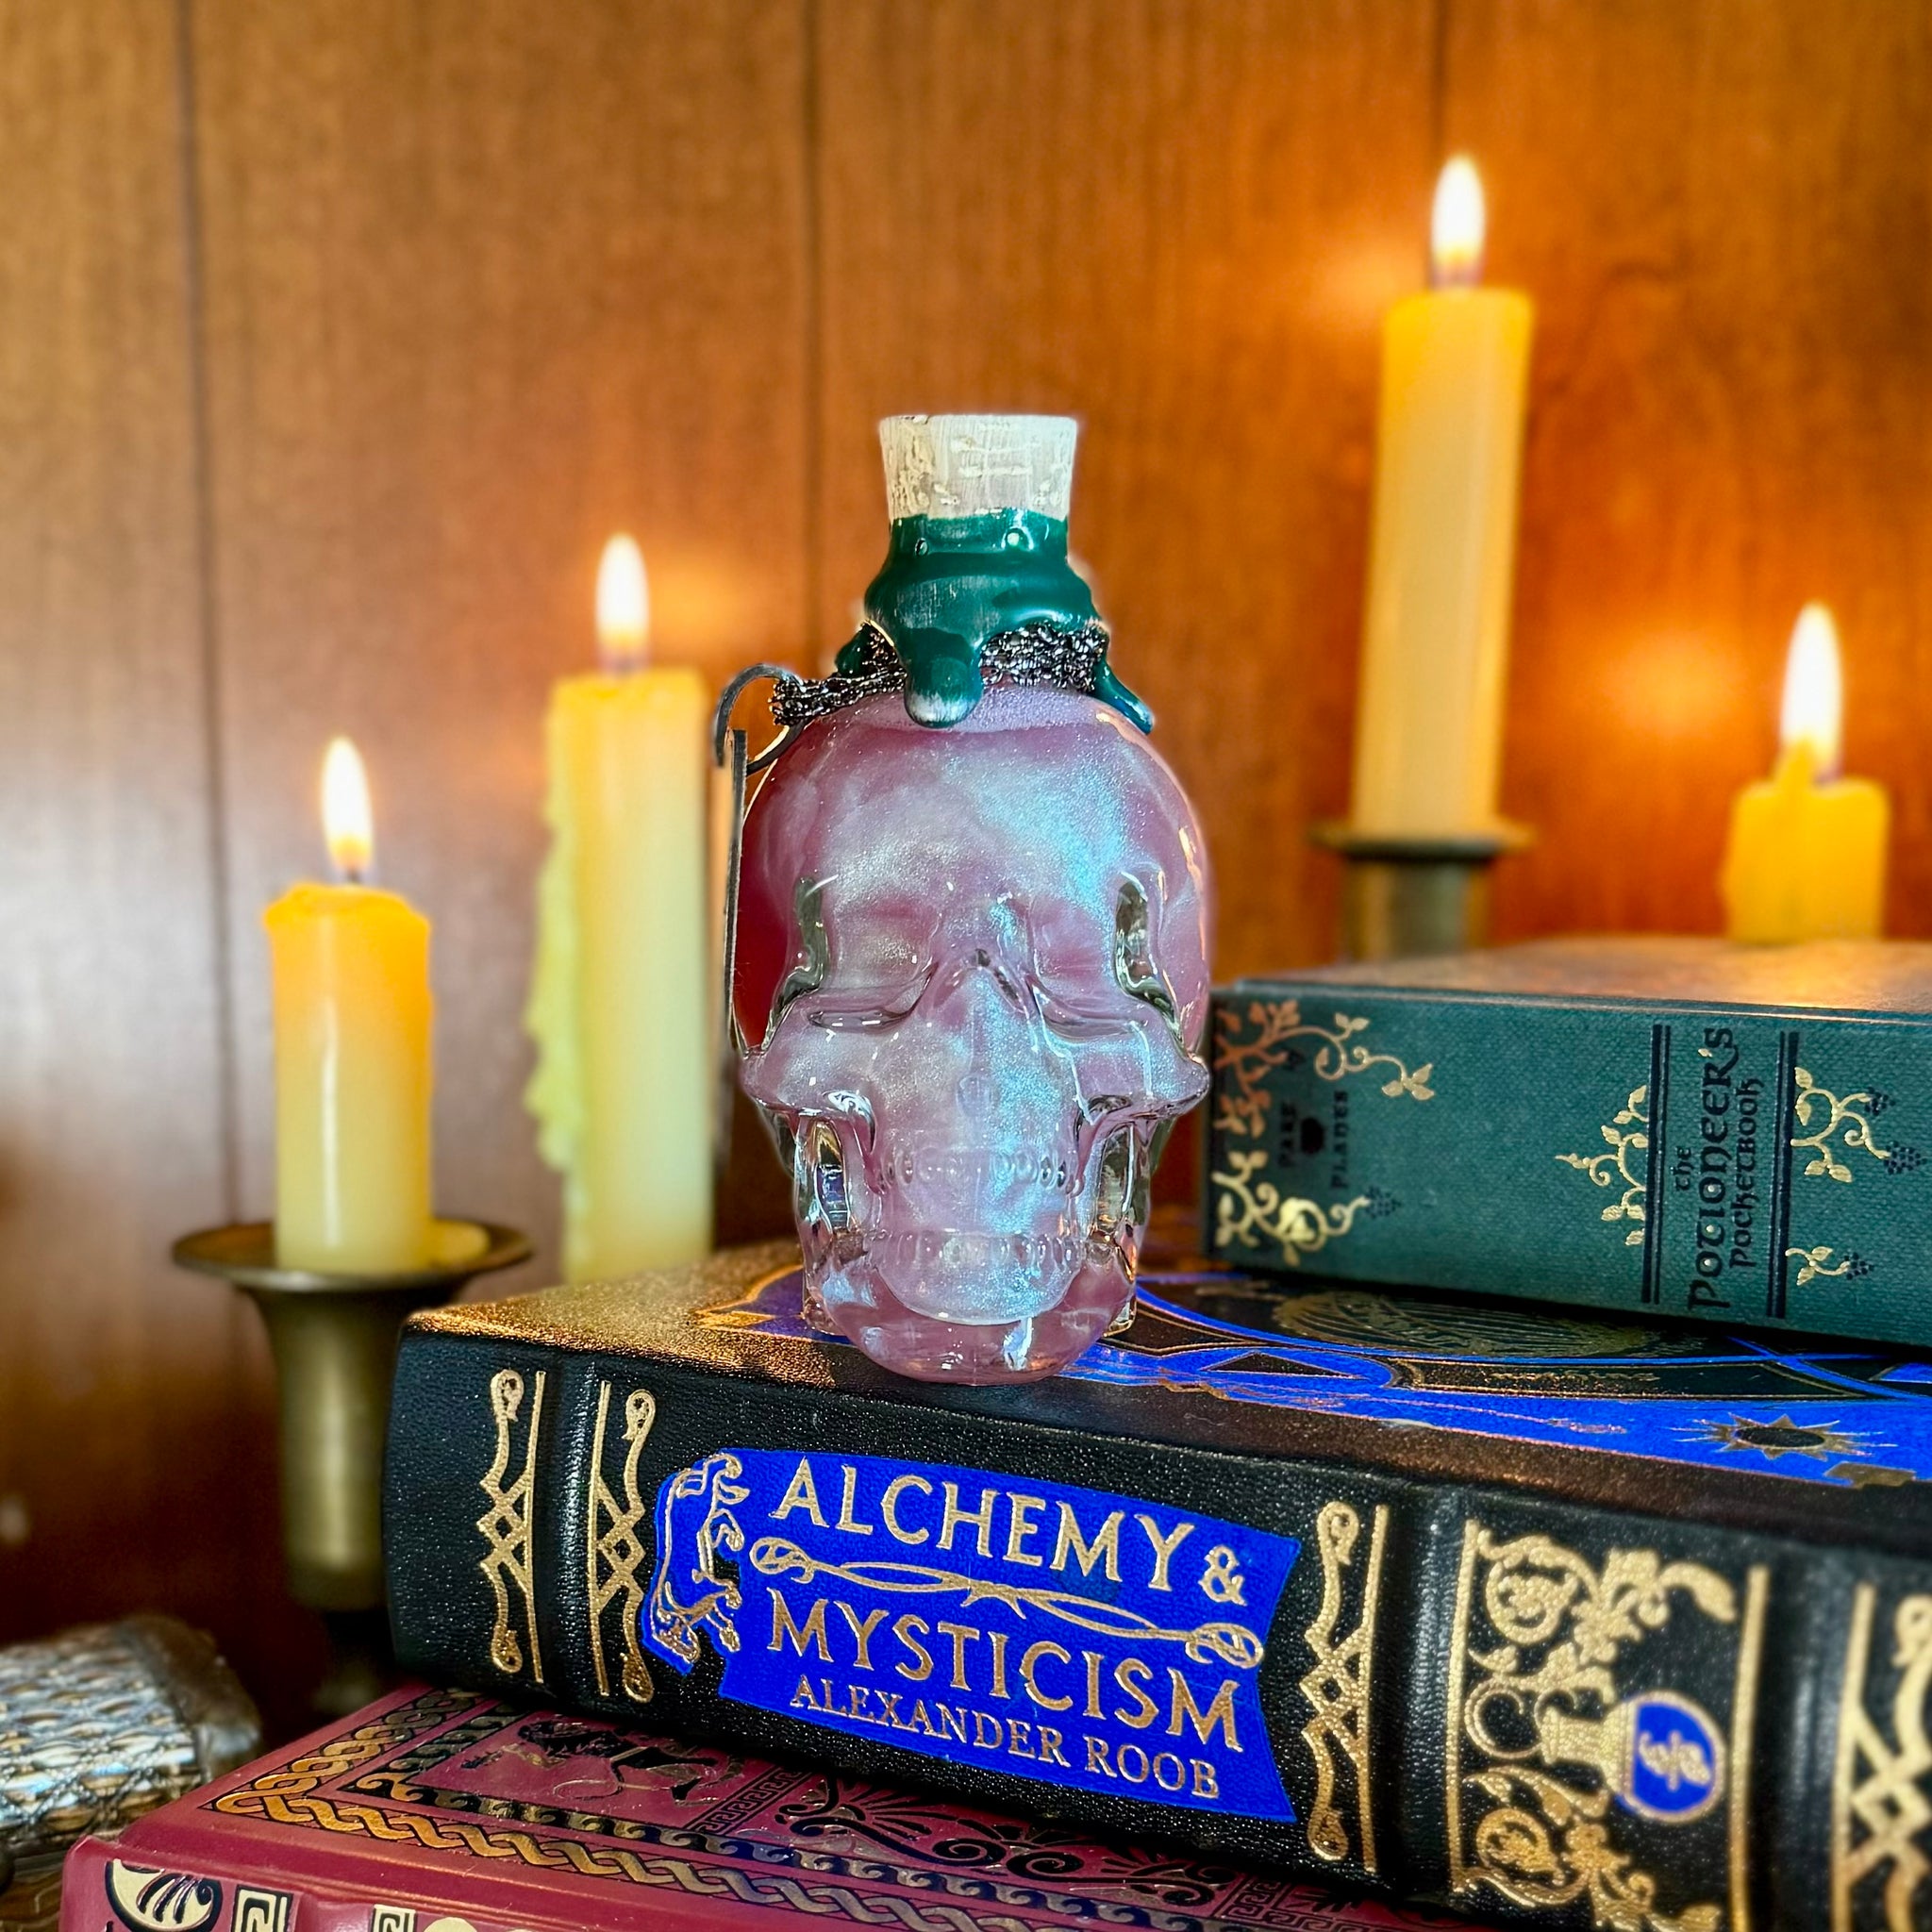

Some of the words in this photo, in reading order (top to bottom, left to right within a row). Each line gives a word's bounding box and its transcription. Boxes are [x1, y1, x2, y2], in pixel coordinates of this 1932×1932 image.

[769, 1457, 1196, 1594] ALCHEMY
[1200, 1544, 1246, 1607] &
[766, 1587, 1243, 1752] MYSTICISM
[790, 1674, 1072, 1768] ALEXANDER
[1085, 1736, 1220, 1800] ROOB
